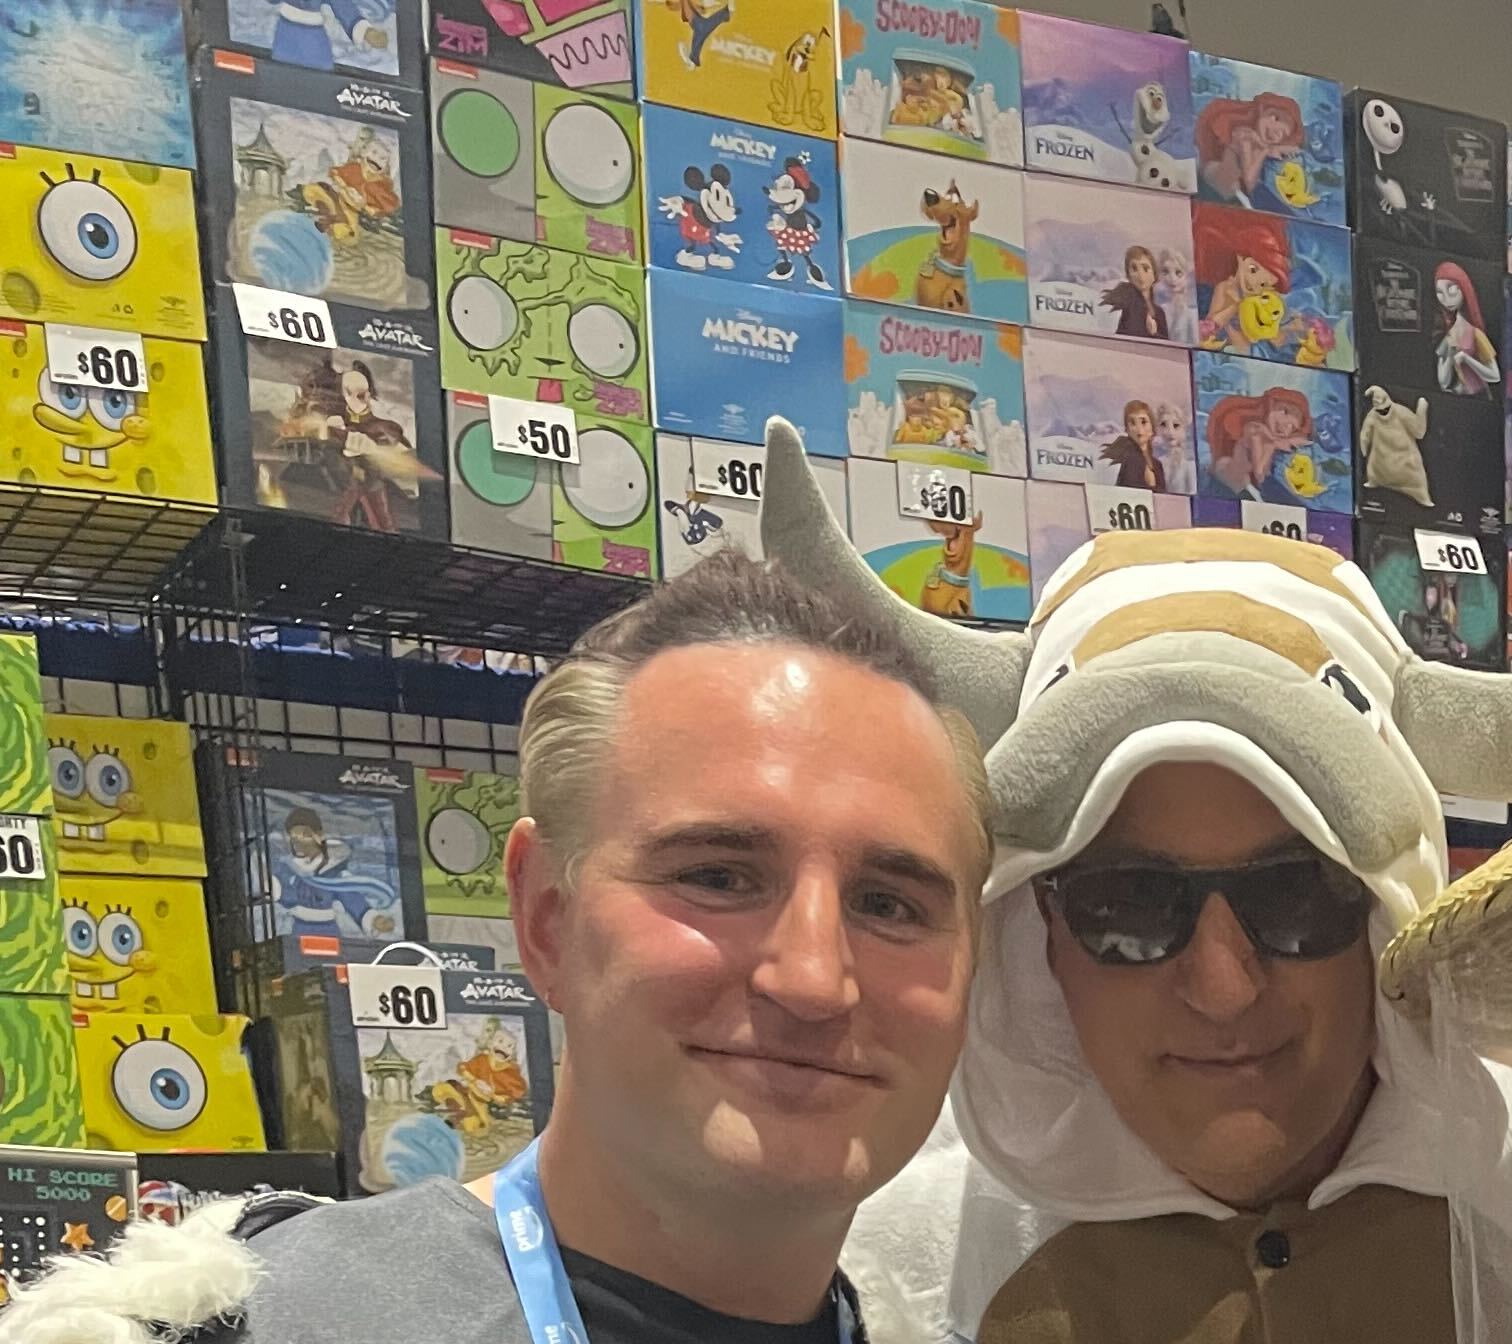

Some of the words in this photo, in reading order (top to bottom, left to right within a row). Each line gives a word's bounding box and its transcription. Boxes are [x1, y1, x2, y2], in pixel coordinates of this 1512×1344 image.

[337, 87, 411, 117] AVATAR
[711, 131, 776, 159] MICKEY
[1036, 138, 1095, 161] FROZEN
[1036, 295, 1094, 316] FROZEN
[267, 309, 326, 343] $60
[359, 323, 433, 351] AVATAR
[702, 318, 800, 353] MICKEY
[78, 347, 139, 389] $60
[518, 420, 571, 459] $50
[1037, 450, 1094, 470] FROZEN
[1437, 543, 1479, 571] $60
[378, 985, 437, 1026] $60
[460, 983, 536, 1001] AVATAR
[8, 1168, 35, 1183] HI
[50, 1170, 118, 1187] SCORE
[36, 1186, 90, 1201] 5000
[510, 1210, 535, 1252] prime
